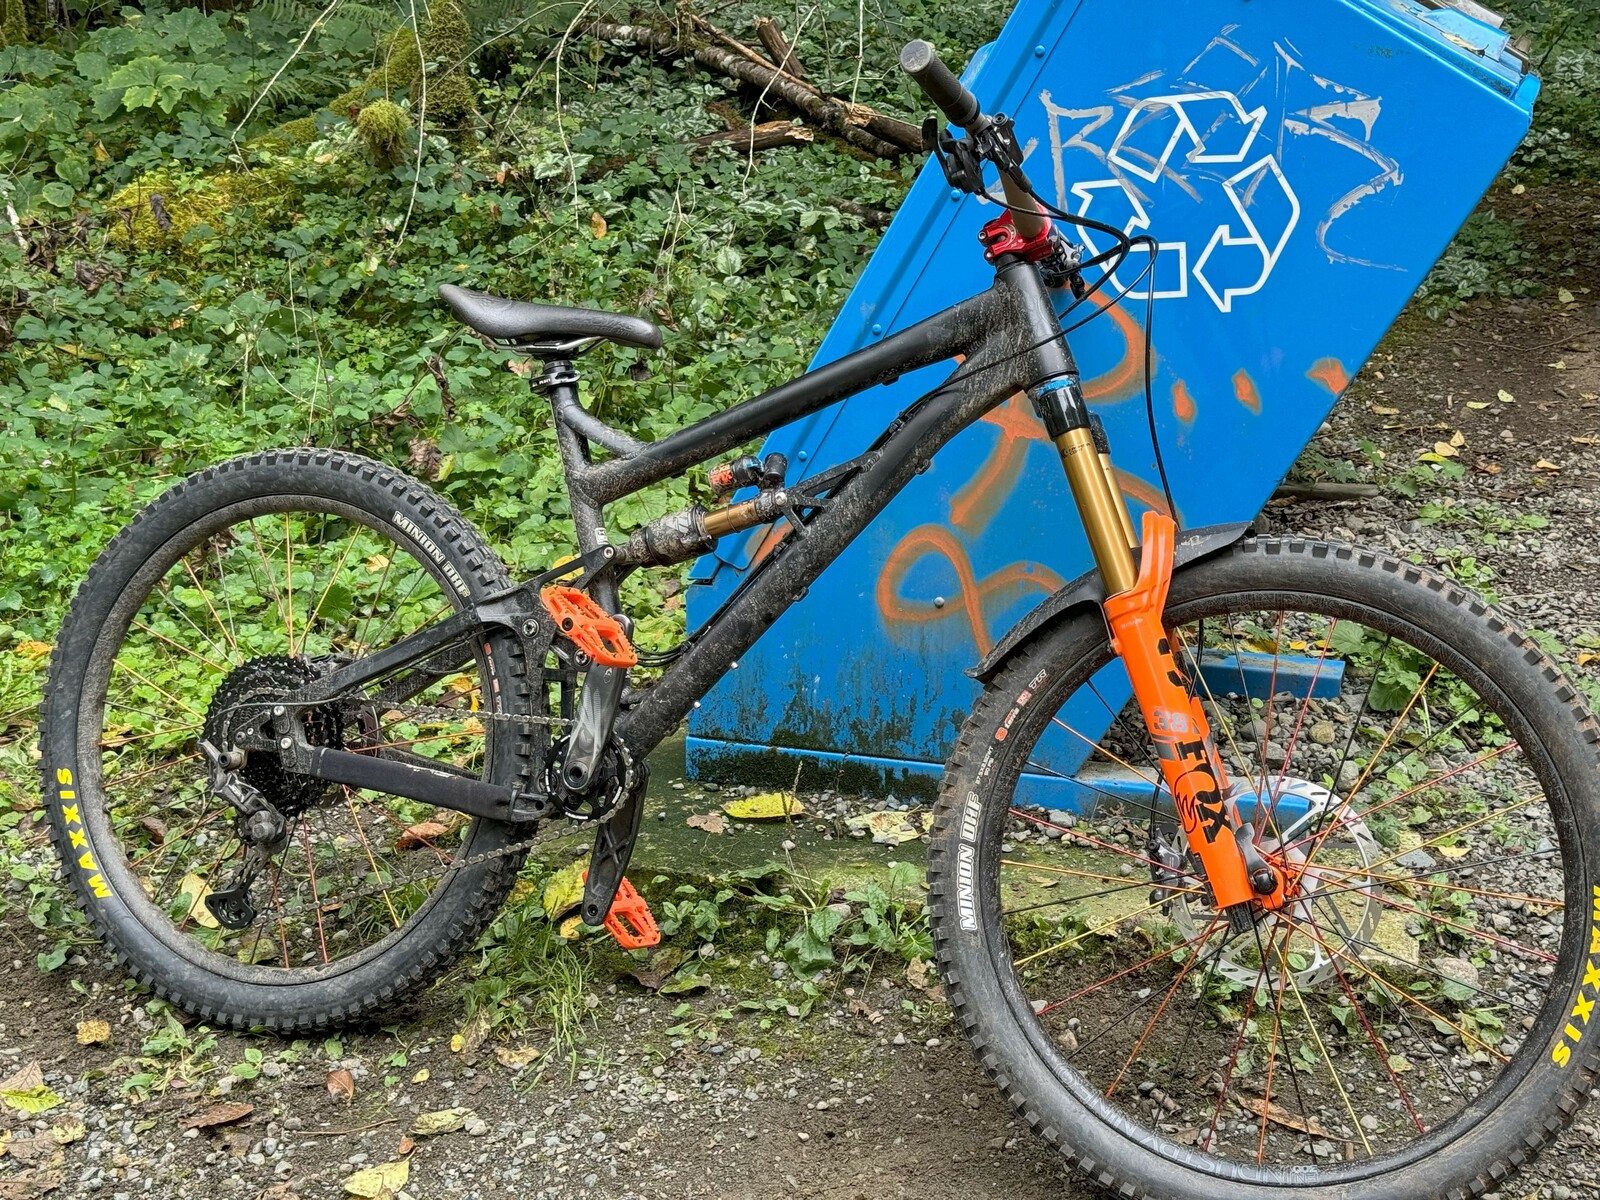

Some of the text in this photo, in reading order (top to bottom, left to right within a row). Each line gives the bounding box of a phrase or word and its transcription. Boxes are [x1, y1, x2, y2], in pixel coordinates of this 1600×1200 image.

[392, 511, 470, 597] MINION DHF
[1153, 710, 1189, 733] 38
[57, 767, 113, 899] MAXXIS
[1174, 737, 1233, 844] FOX
[957, 790, 982, 931] MINION DHF
[1079, 1084, 1292, 1186] INDUSTRY NINE
